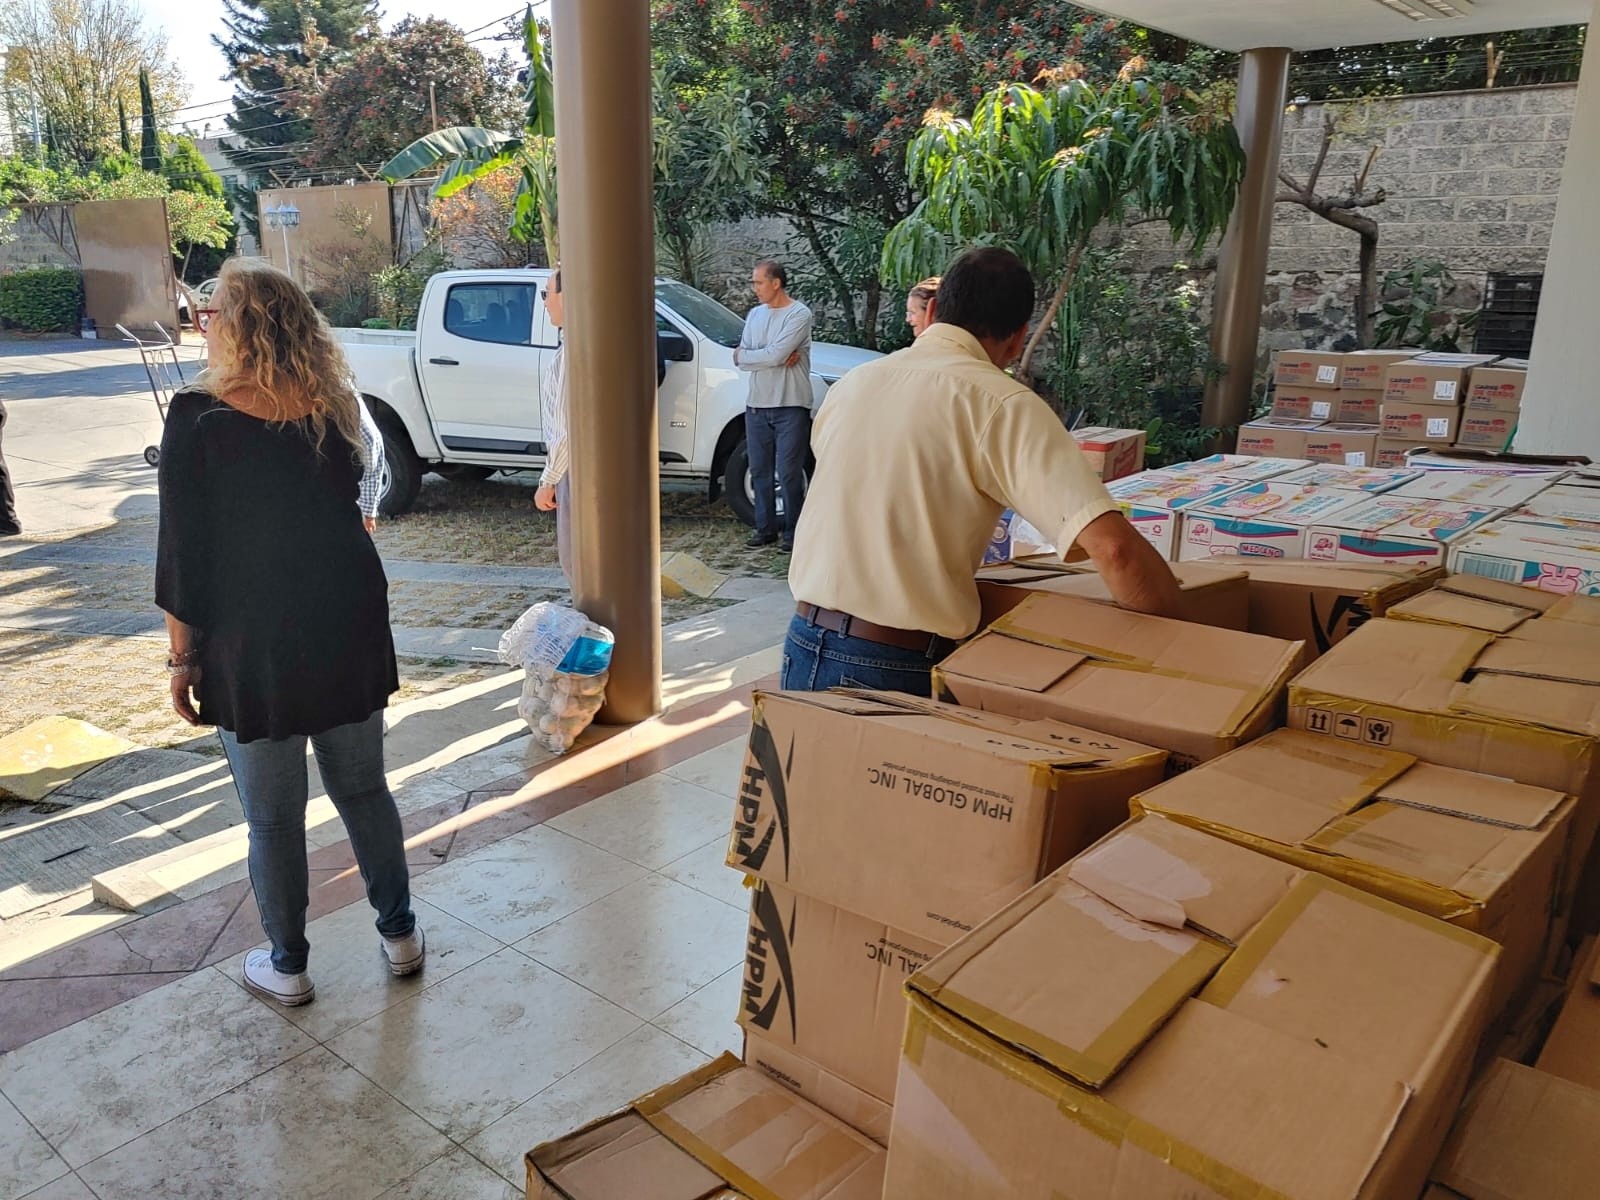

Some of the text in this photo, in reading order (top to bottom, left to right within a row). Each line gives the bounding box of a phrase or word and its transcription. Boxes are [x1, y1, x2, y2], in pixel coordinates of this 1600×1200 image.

[1242, 545, 1281, 557] MEDIANO
[734, 765, 766, 858] HPM
[867, 767, 1013, 822] HPM GLOBAL INC.
[743, 925, 769, 1015] HPM
[865, 941, 893, 967] INC.
